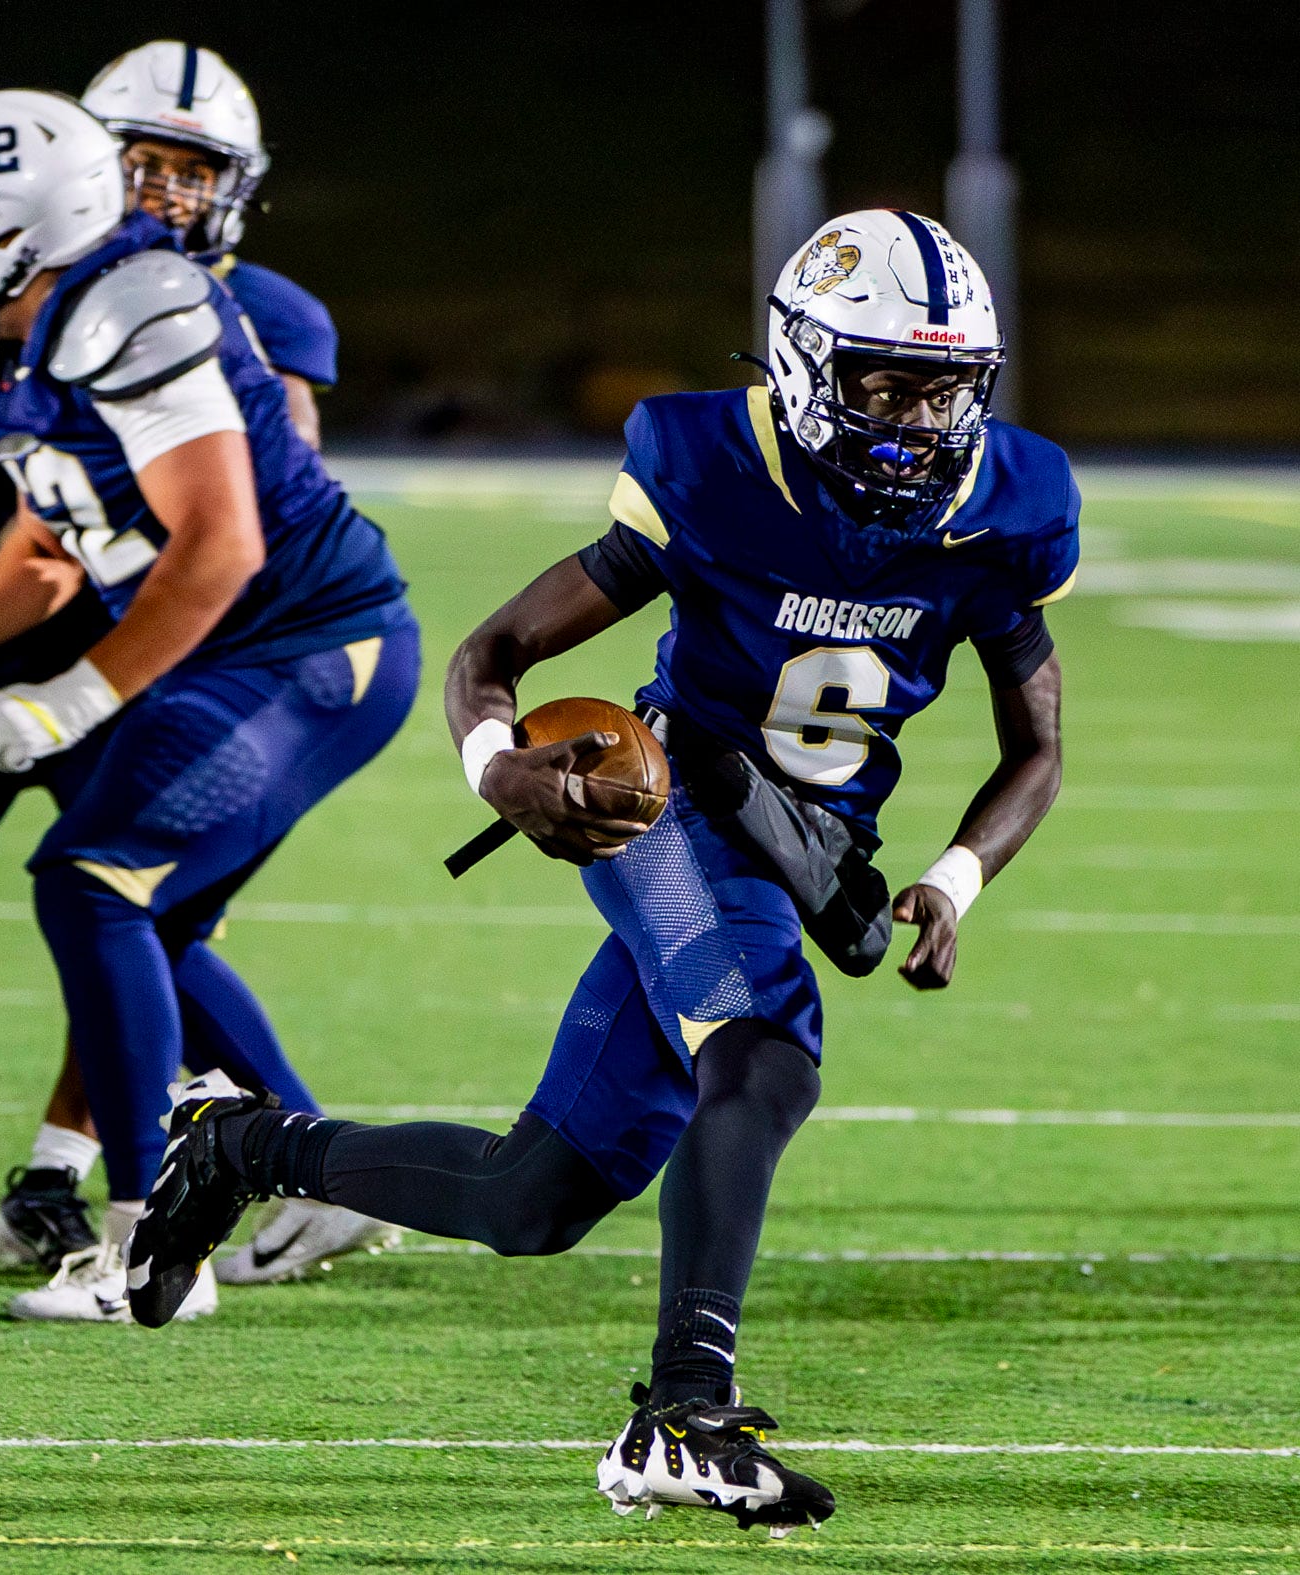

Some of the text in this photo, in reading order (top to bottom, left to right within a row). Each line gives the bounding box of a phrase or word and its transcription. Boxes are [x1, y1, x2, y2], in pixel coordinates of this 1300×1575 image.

[912, 329, 965, 344] Riddell
[774, 592, 923, 640] ROBERSON
[760, 646, 890, 786] 6
